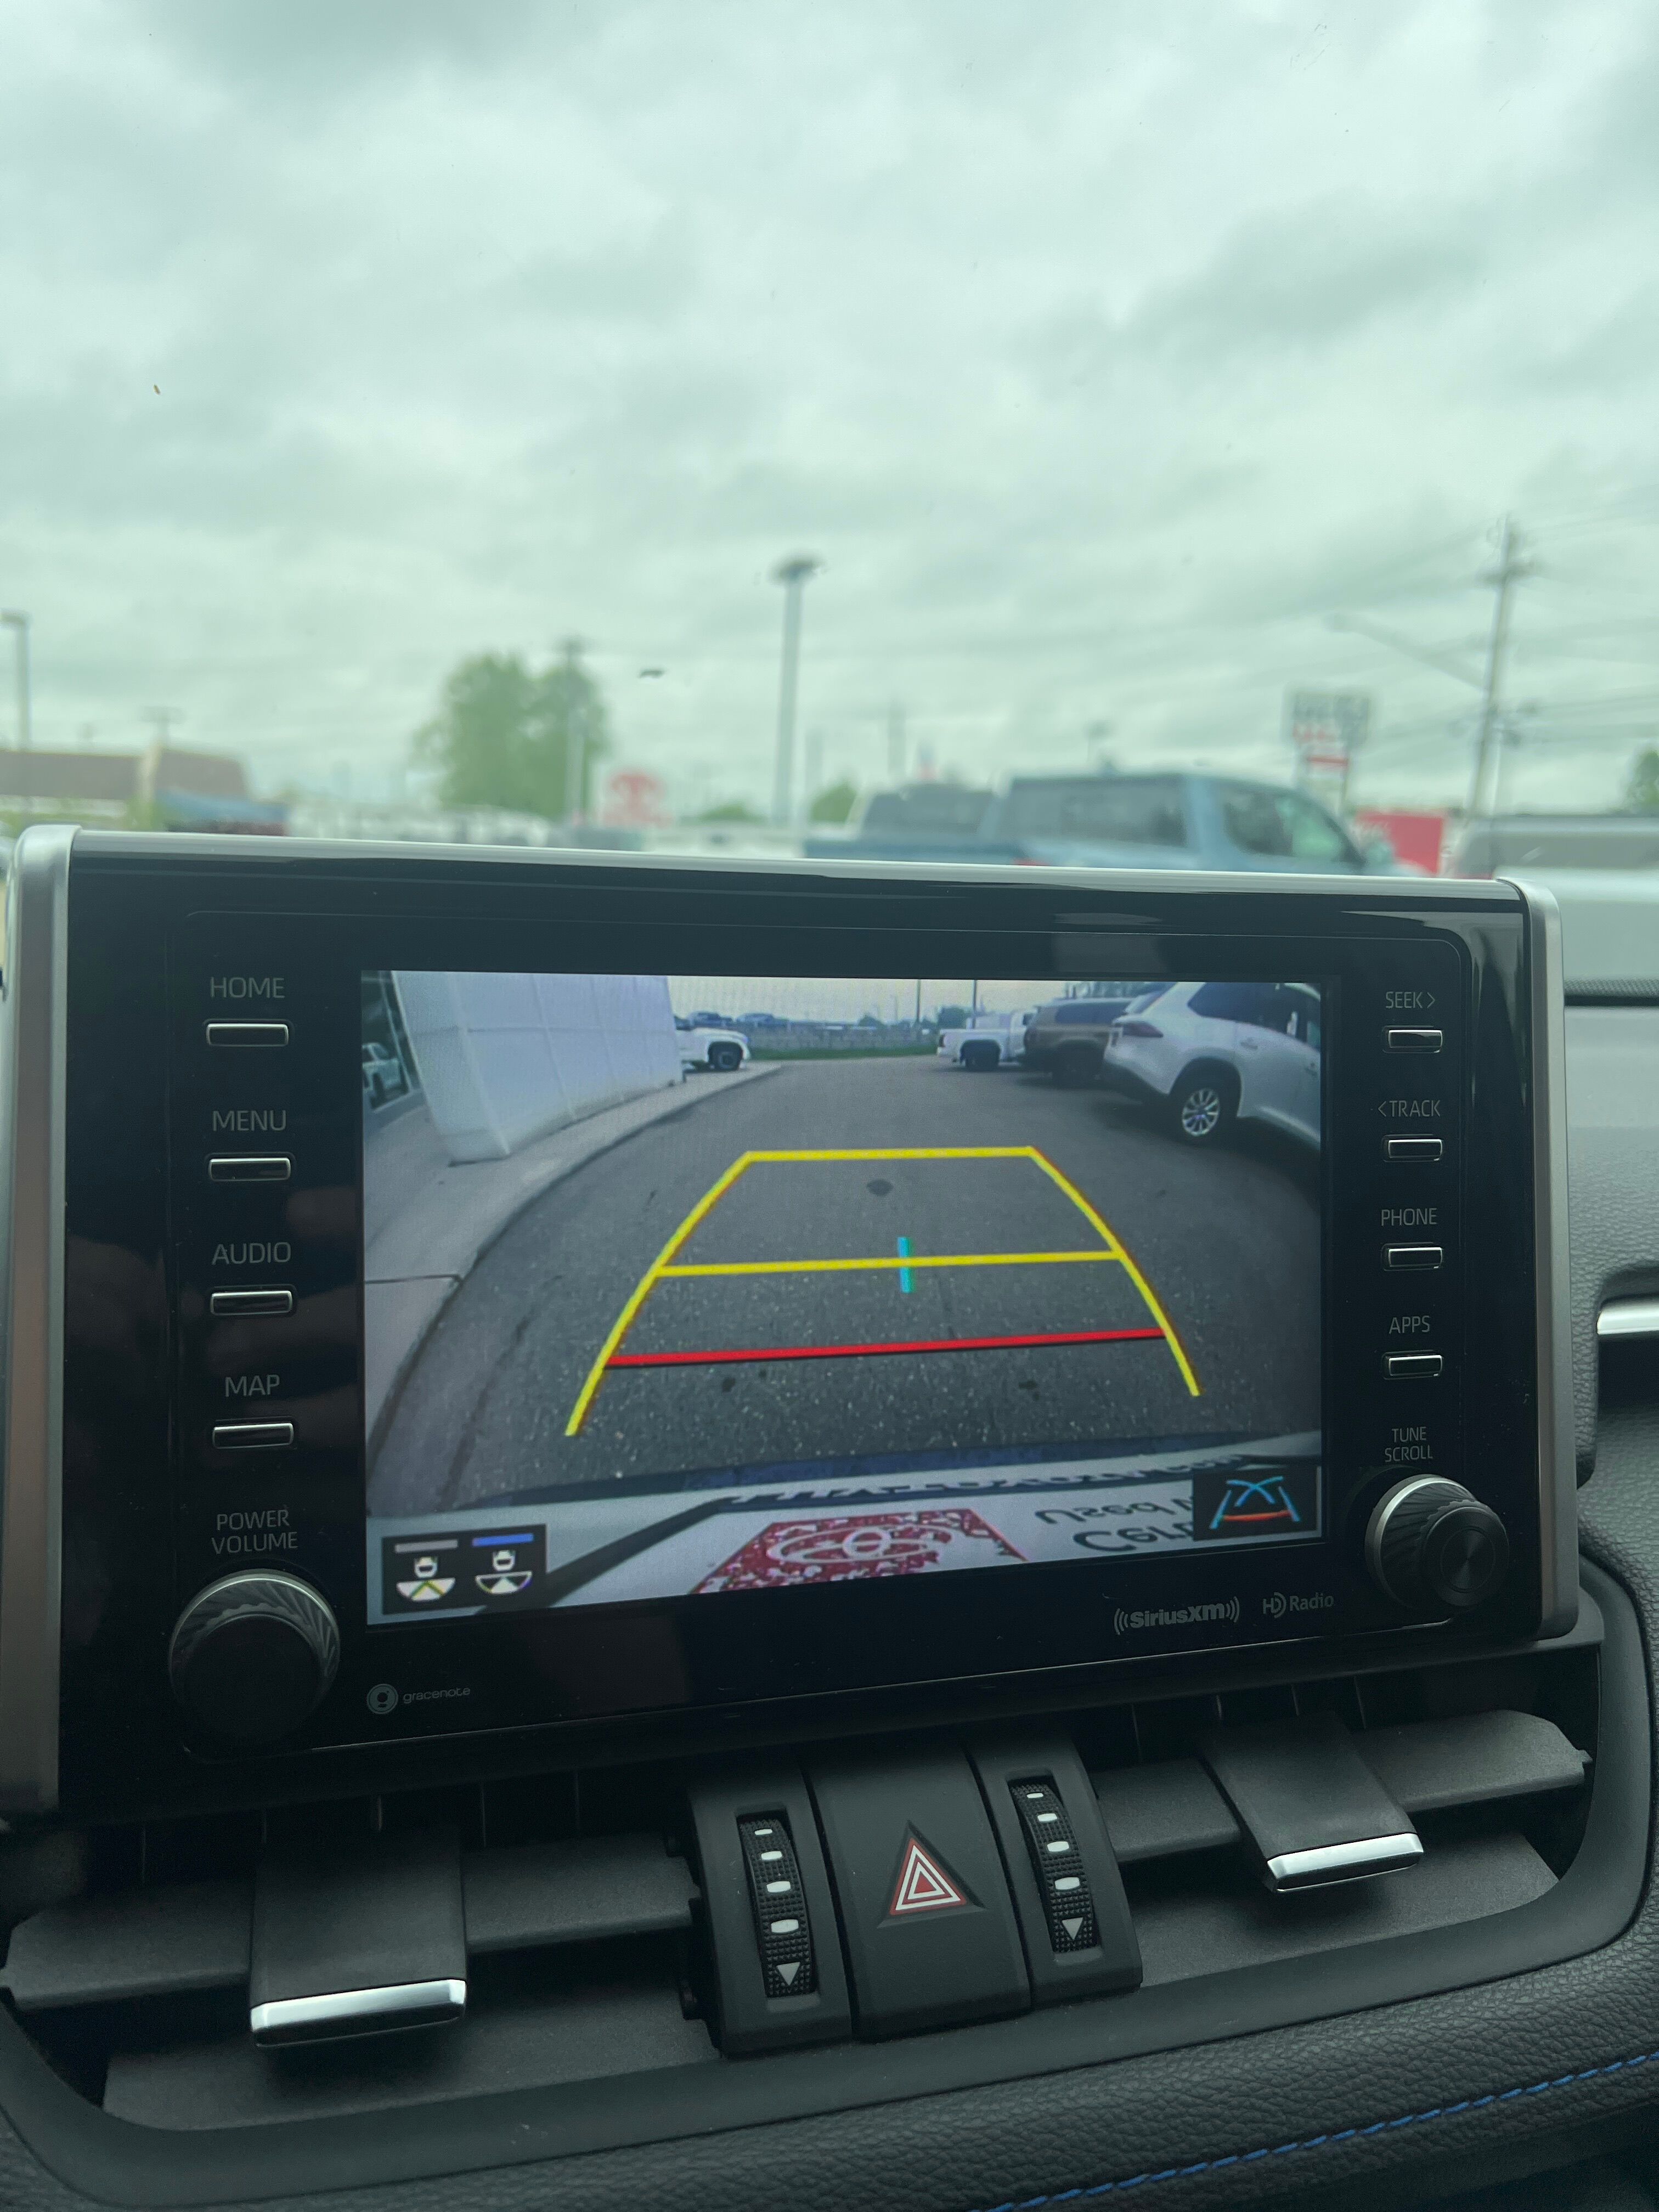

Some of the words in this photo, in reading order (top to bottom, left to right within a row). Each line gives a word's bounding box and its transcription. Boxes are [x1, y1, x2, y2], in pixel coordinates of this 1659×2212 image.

[210, 977, 285, 998] HOME
[1385, 991, 1423, 1009] SEEK
[1389, 1099, 1441, 1118] TRACK
[212, 1110, 286, 1131] MENU
[1381, 1207, 1437, 1226] PHONE
[212, 1242, 291, 1265] AUDIO
[1389, 1315, 1430, 1334] APPS
[225, 1374, 280, 1397] MAP
[1391, 1426, 1427, 1443] TUNE
[1384, 1444, 1434, 1463] SCROLL
[216, 1509, 289, 1531] POWER
[211, 1531, 298, 1554] VOLUME
[1289, 1593, 1334, 1612] Radio
[403, 1687, 471, 1705] gracenote
